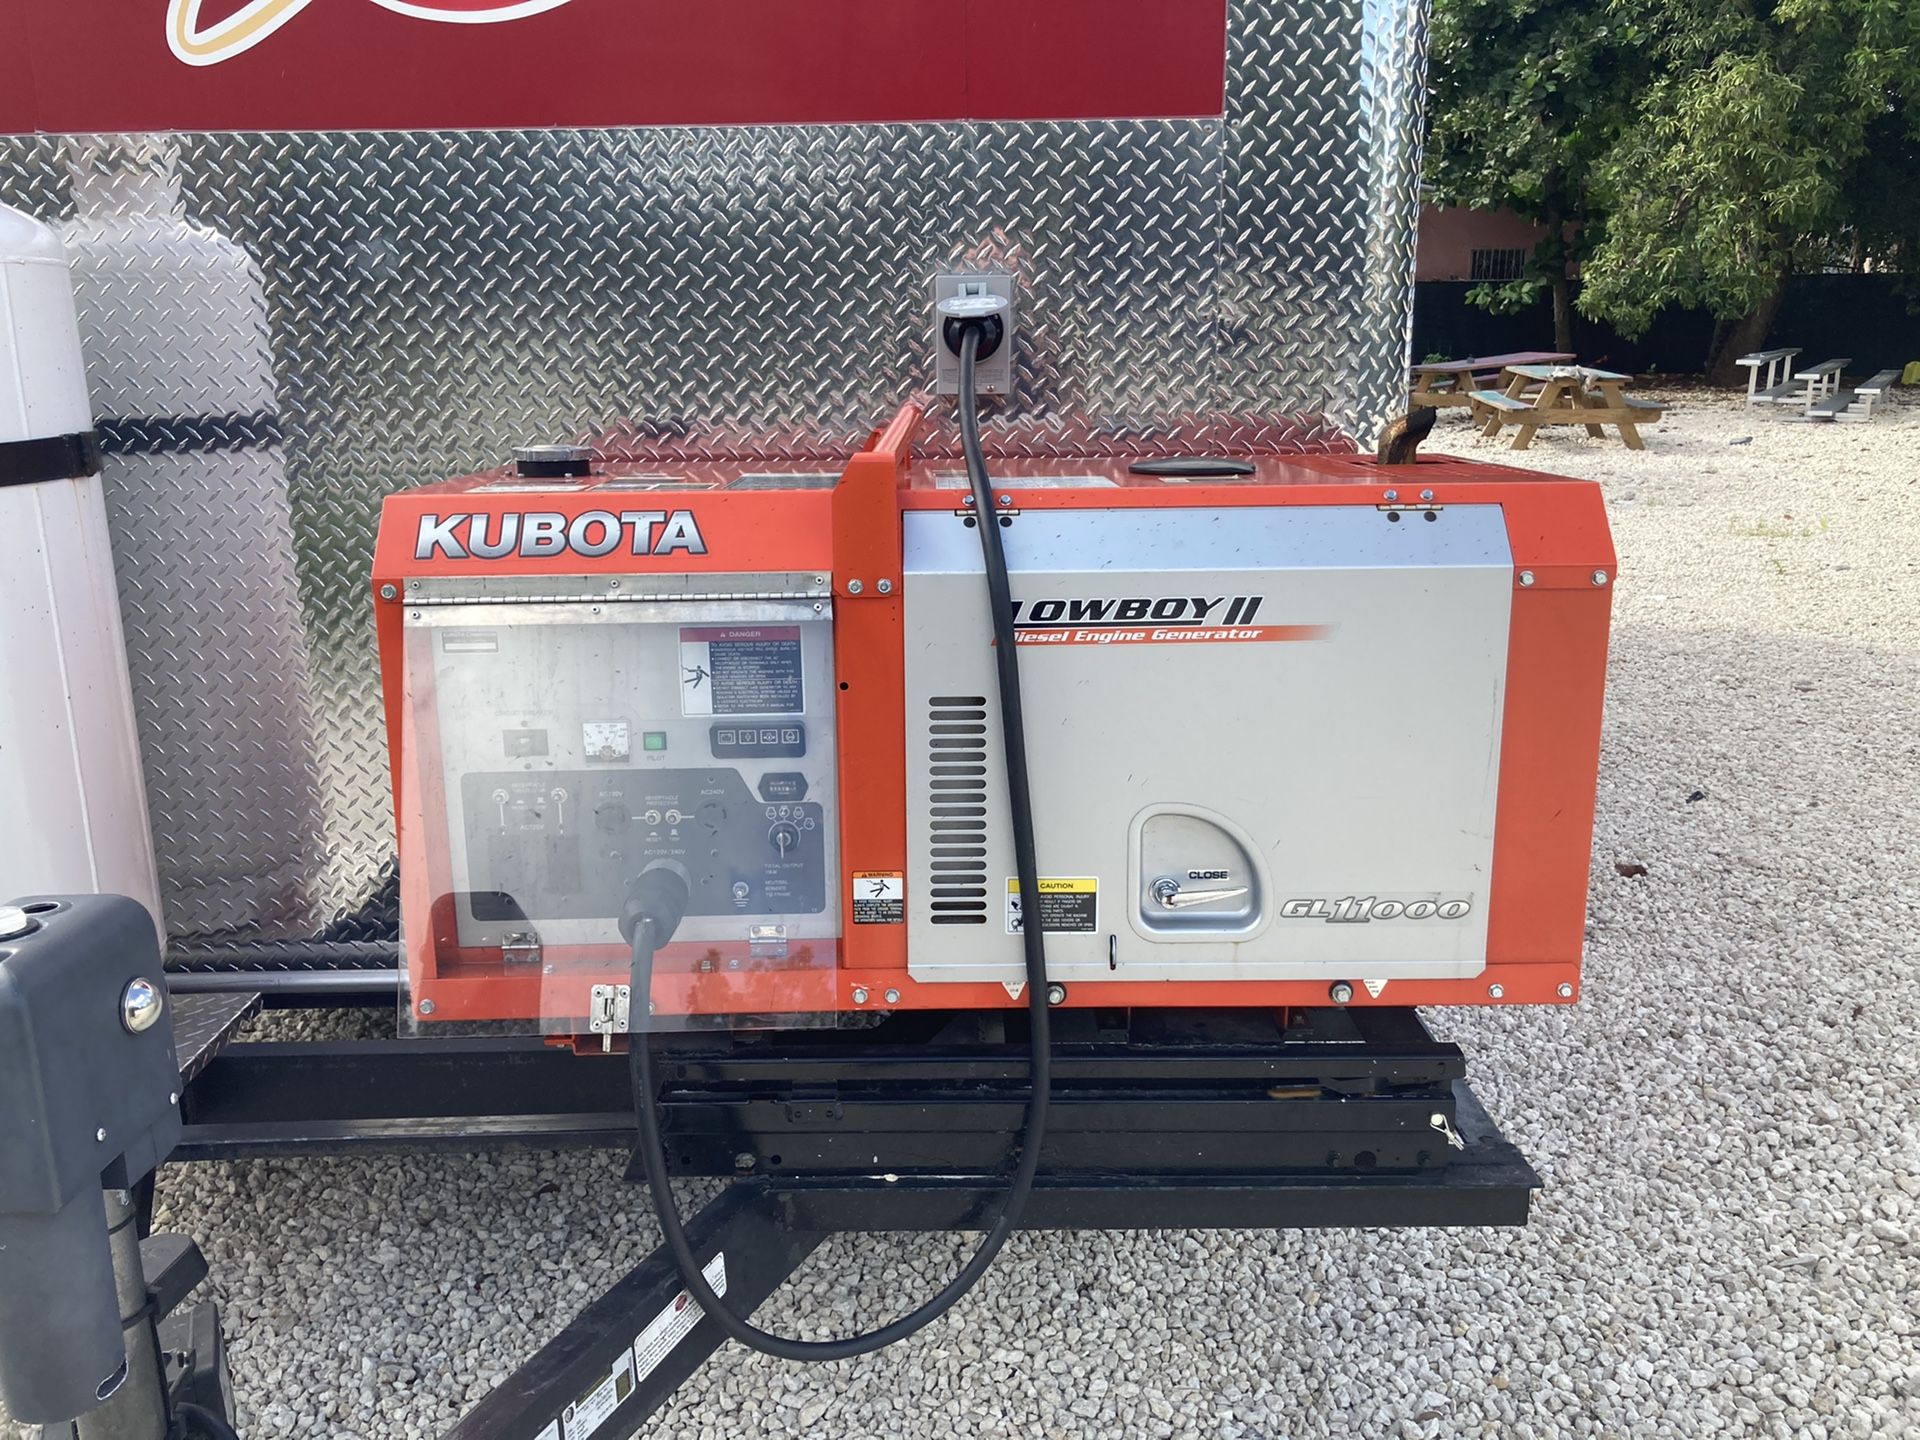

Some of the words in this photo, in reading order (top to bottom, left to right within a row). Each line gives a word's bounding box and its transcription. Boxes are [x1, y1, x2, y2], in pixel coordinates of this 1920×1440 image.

[414, 509, 708, 559] KUBOTA
[1074, 629, 1146, 645] Engine
[1151, 628, 1263, 641] Generator
[1189, 870, 1228, 880] CLOSE
[1280, 896, 1472, 923] GL11000
